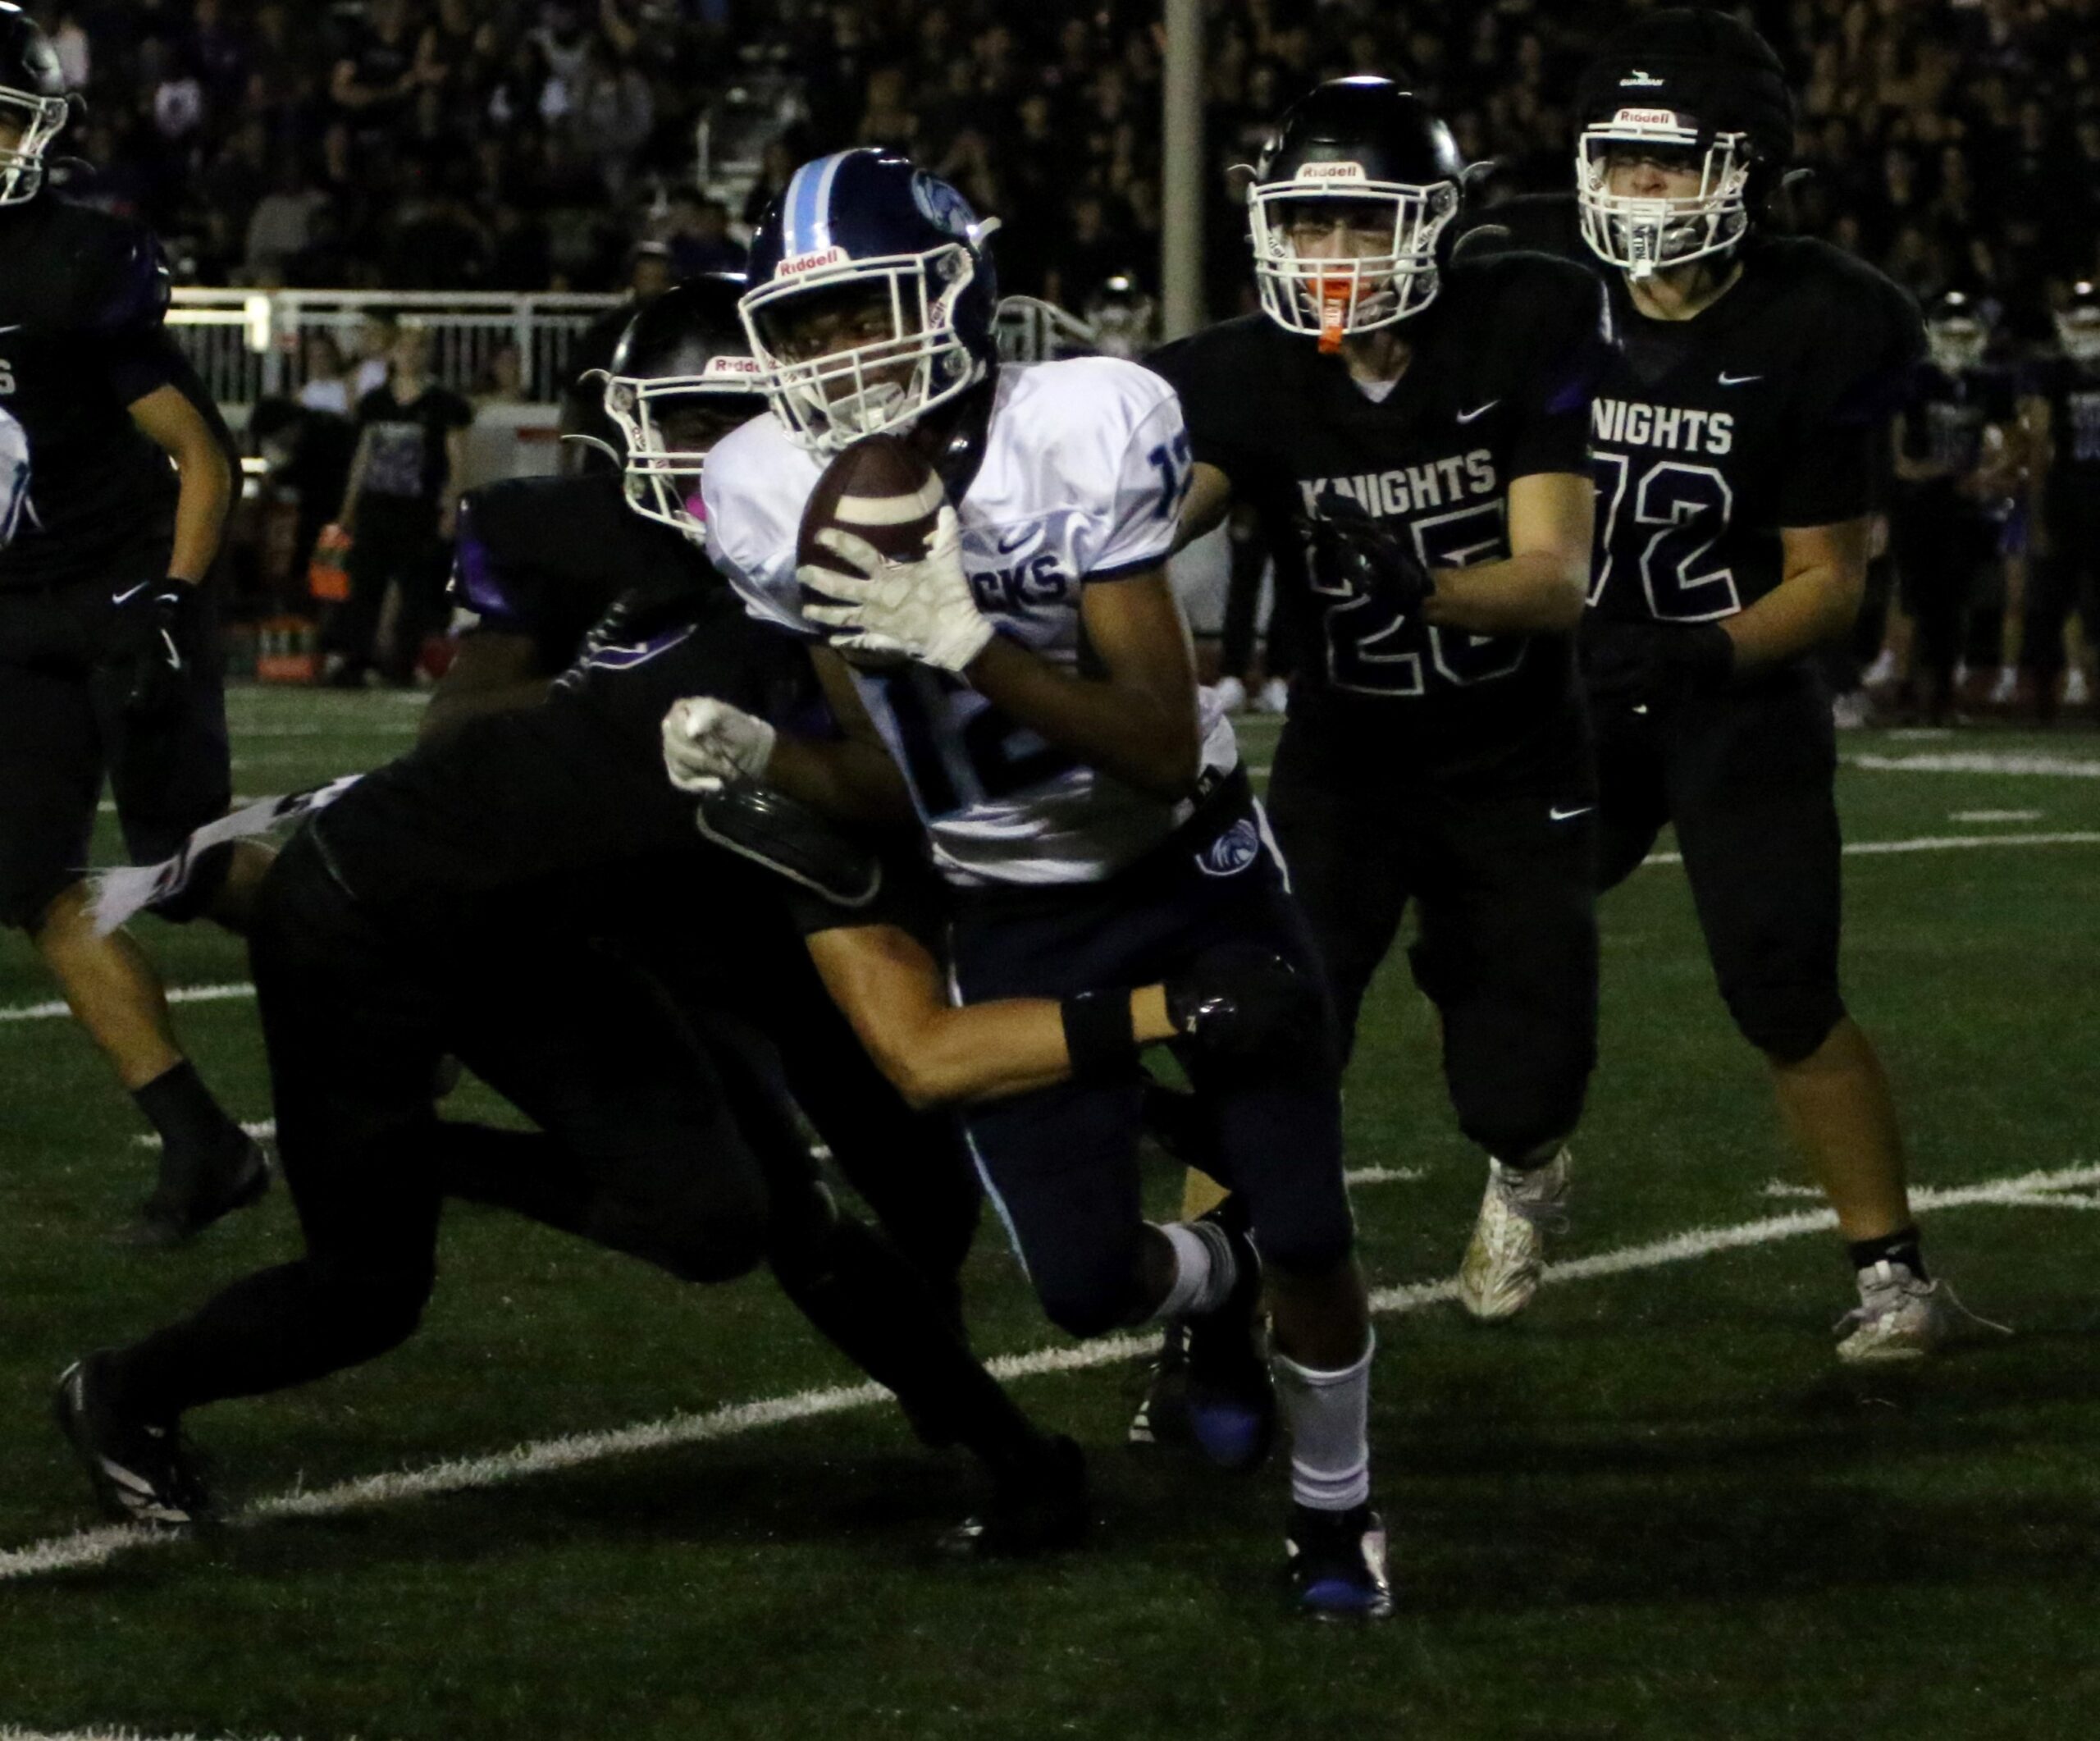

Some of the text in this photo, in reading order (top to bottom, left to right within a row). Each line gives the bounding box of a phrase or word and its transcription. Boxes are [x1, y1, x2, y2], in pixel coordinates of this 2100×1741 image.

[1621, 111, 1670, 124] Riddell
[780, 249, 838, 276] Riddell
[1298, 448, 1497, 522] KNIGHTS
[1585, 450, 1742, 623] 72
